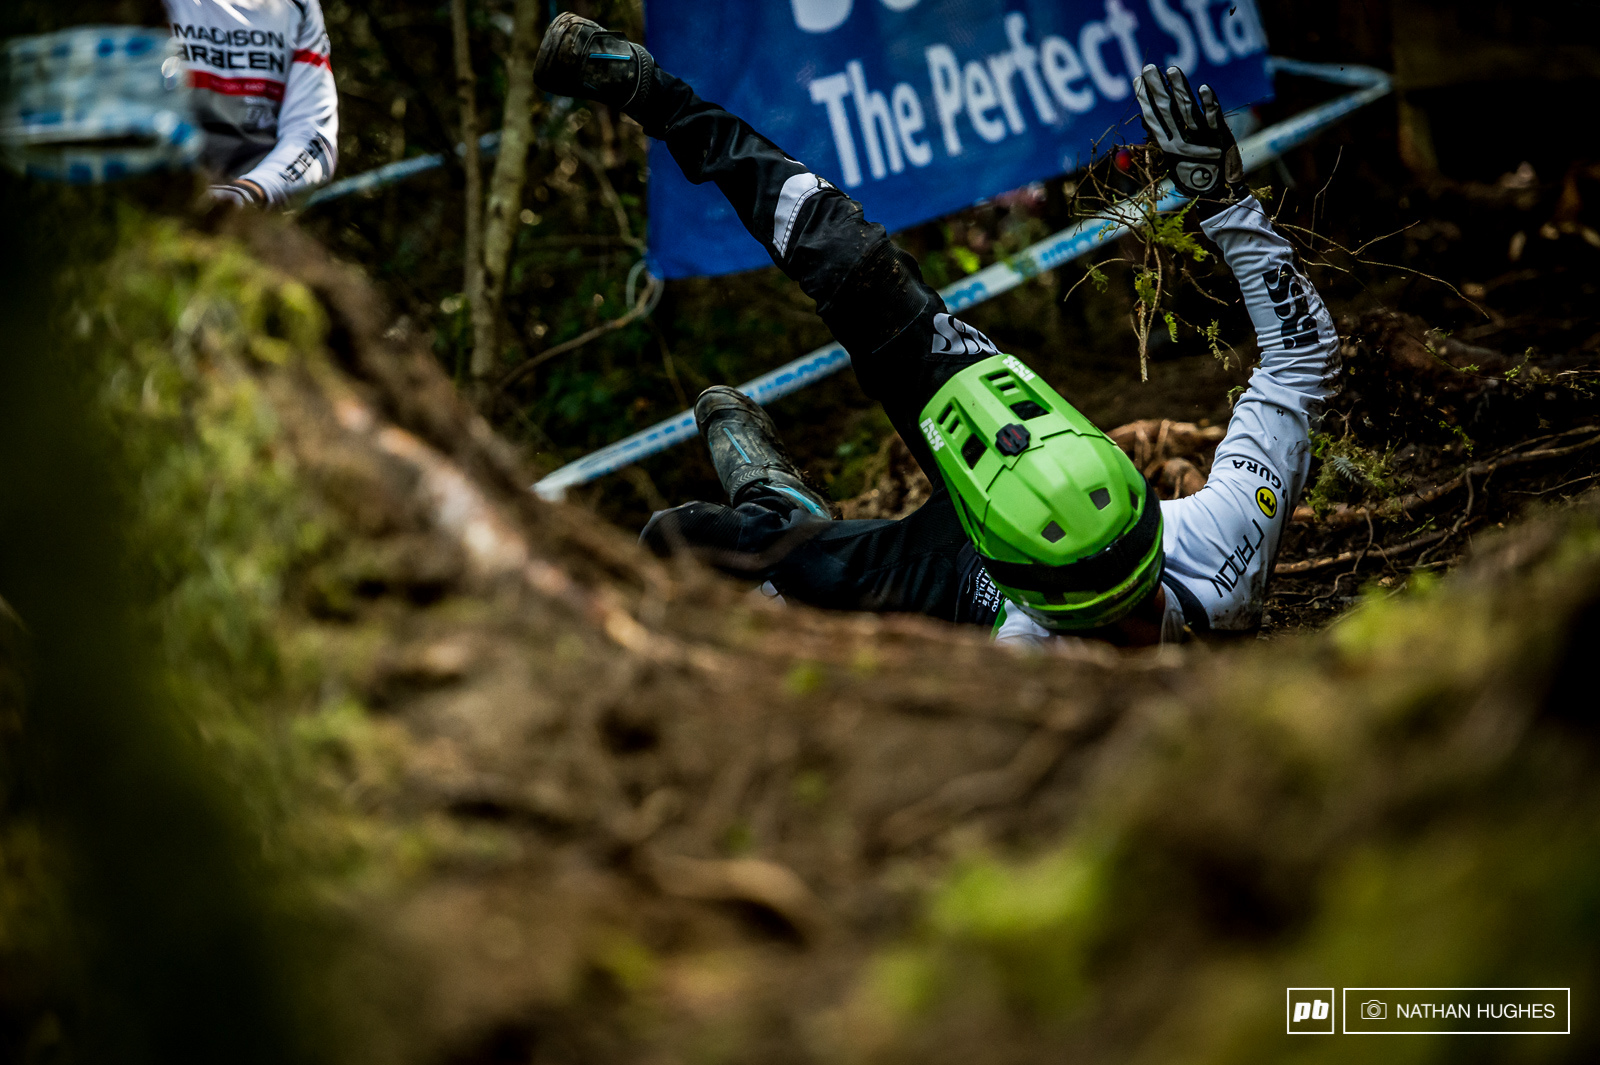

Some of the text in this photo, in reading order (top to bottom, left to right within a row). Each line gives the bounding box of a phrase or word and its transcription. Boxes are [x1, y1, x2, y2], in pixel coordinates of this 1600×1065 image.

[172, 22, 285, 49] MADISON
[809, 60, 933, 188] The
[925, 0, 1144, 157] Perfect
[1232, 459, 1287, 500] GURA
